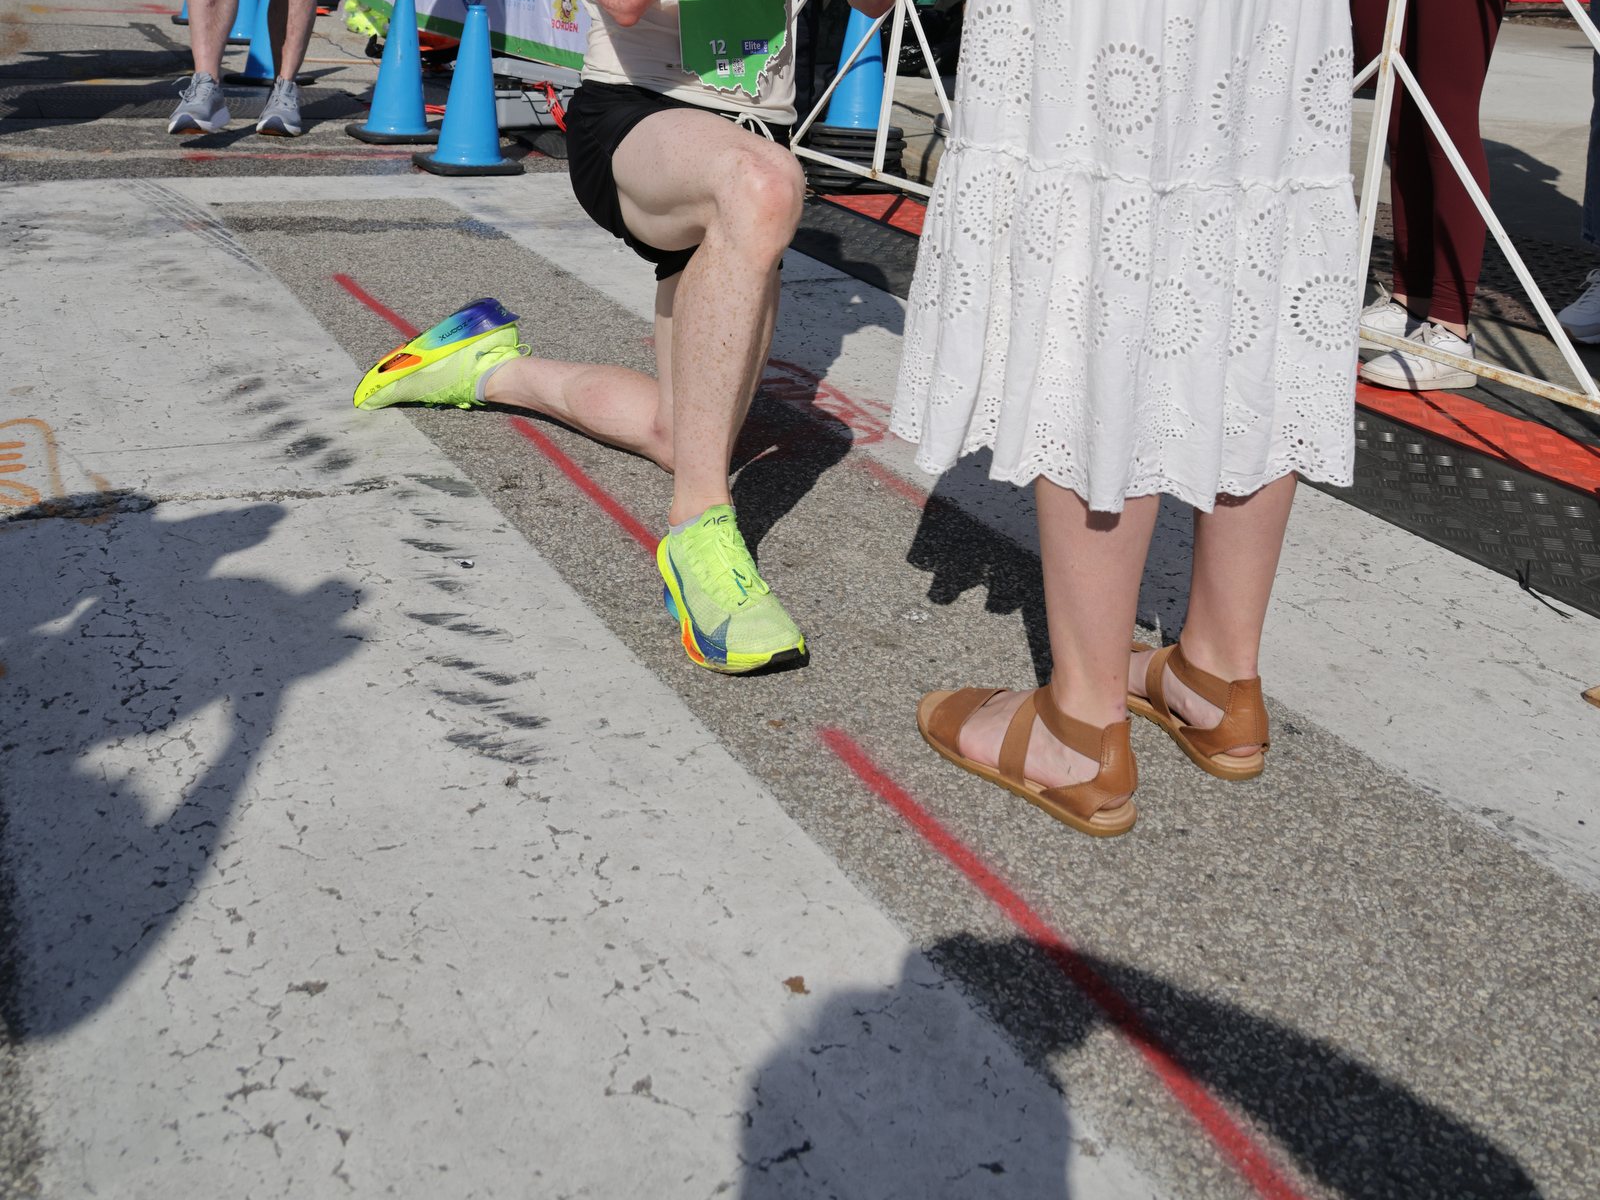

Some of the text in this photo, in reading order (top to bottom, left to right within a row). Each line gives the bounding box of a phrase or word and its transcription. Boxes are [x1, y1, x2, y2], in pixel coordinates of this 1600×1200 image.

[709, 39, 727, 55] 12
[744, 41, 761, 50] Elite
[718, 63, 728, 71] EL
